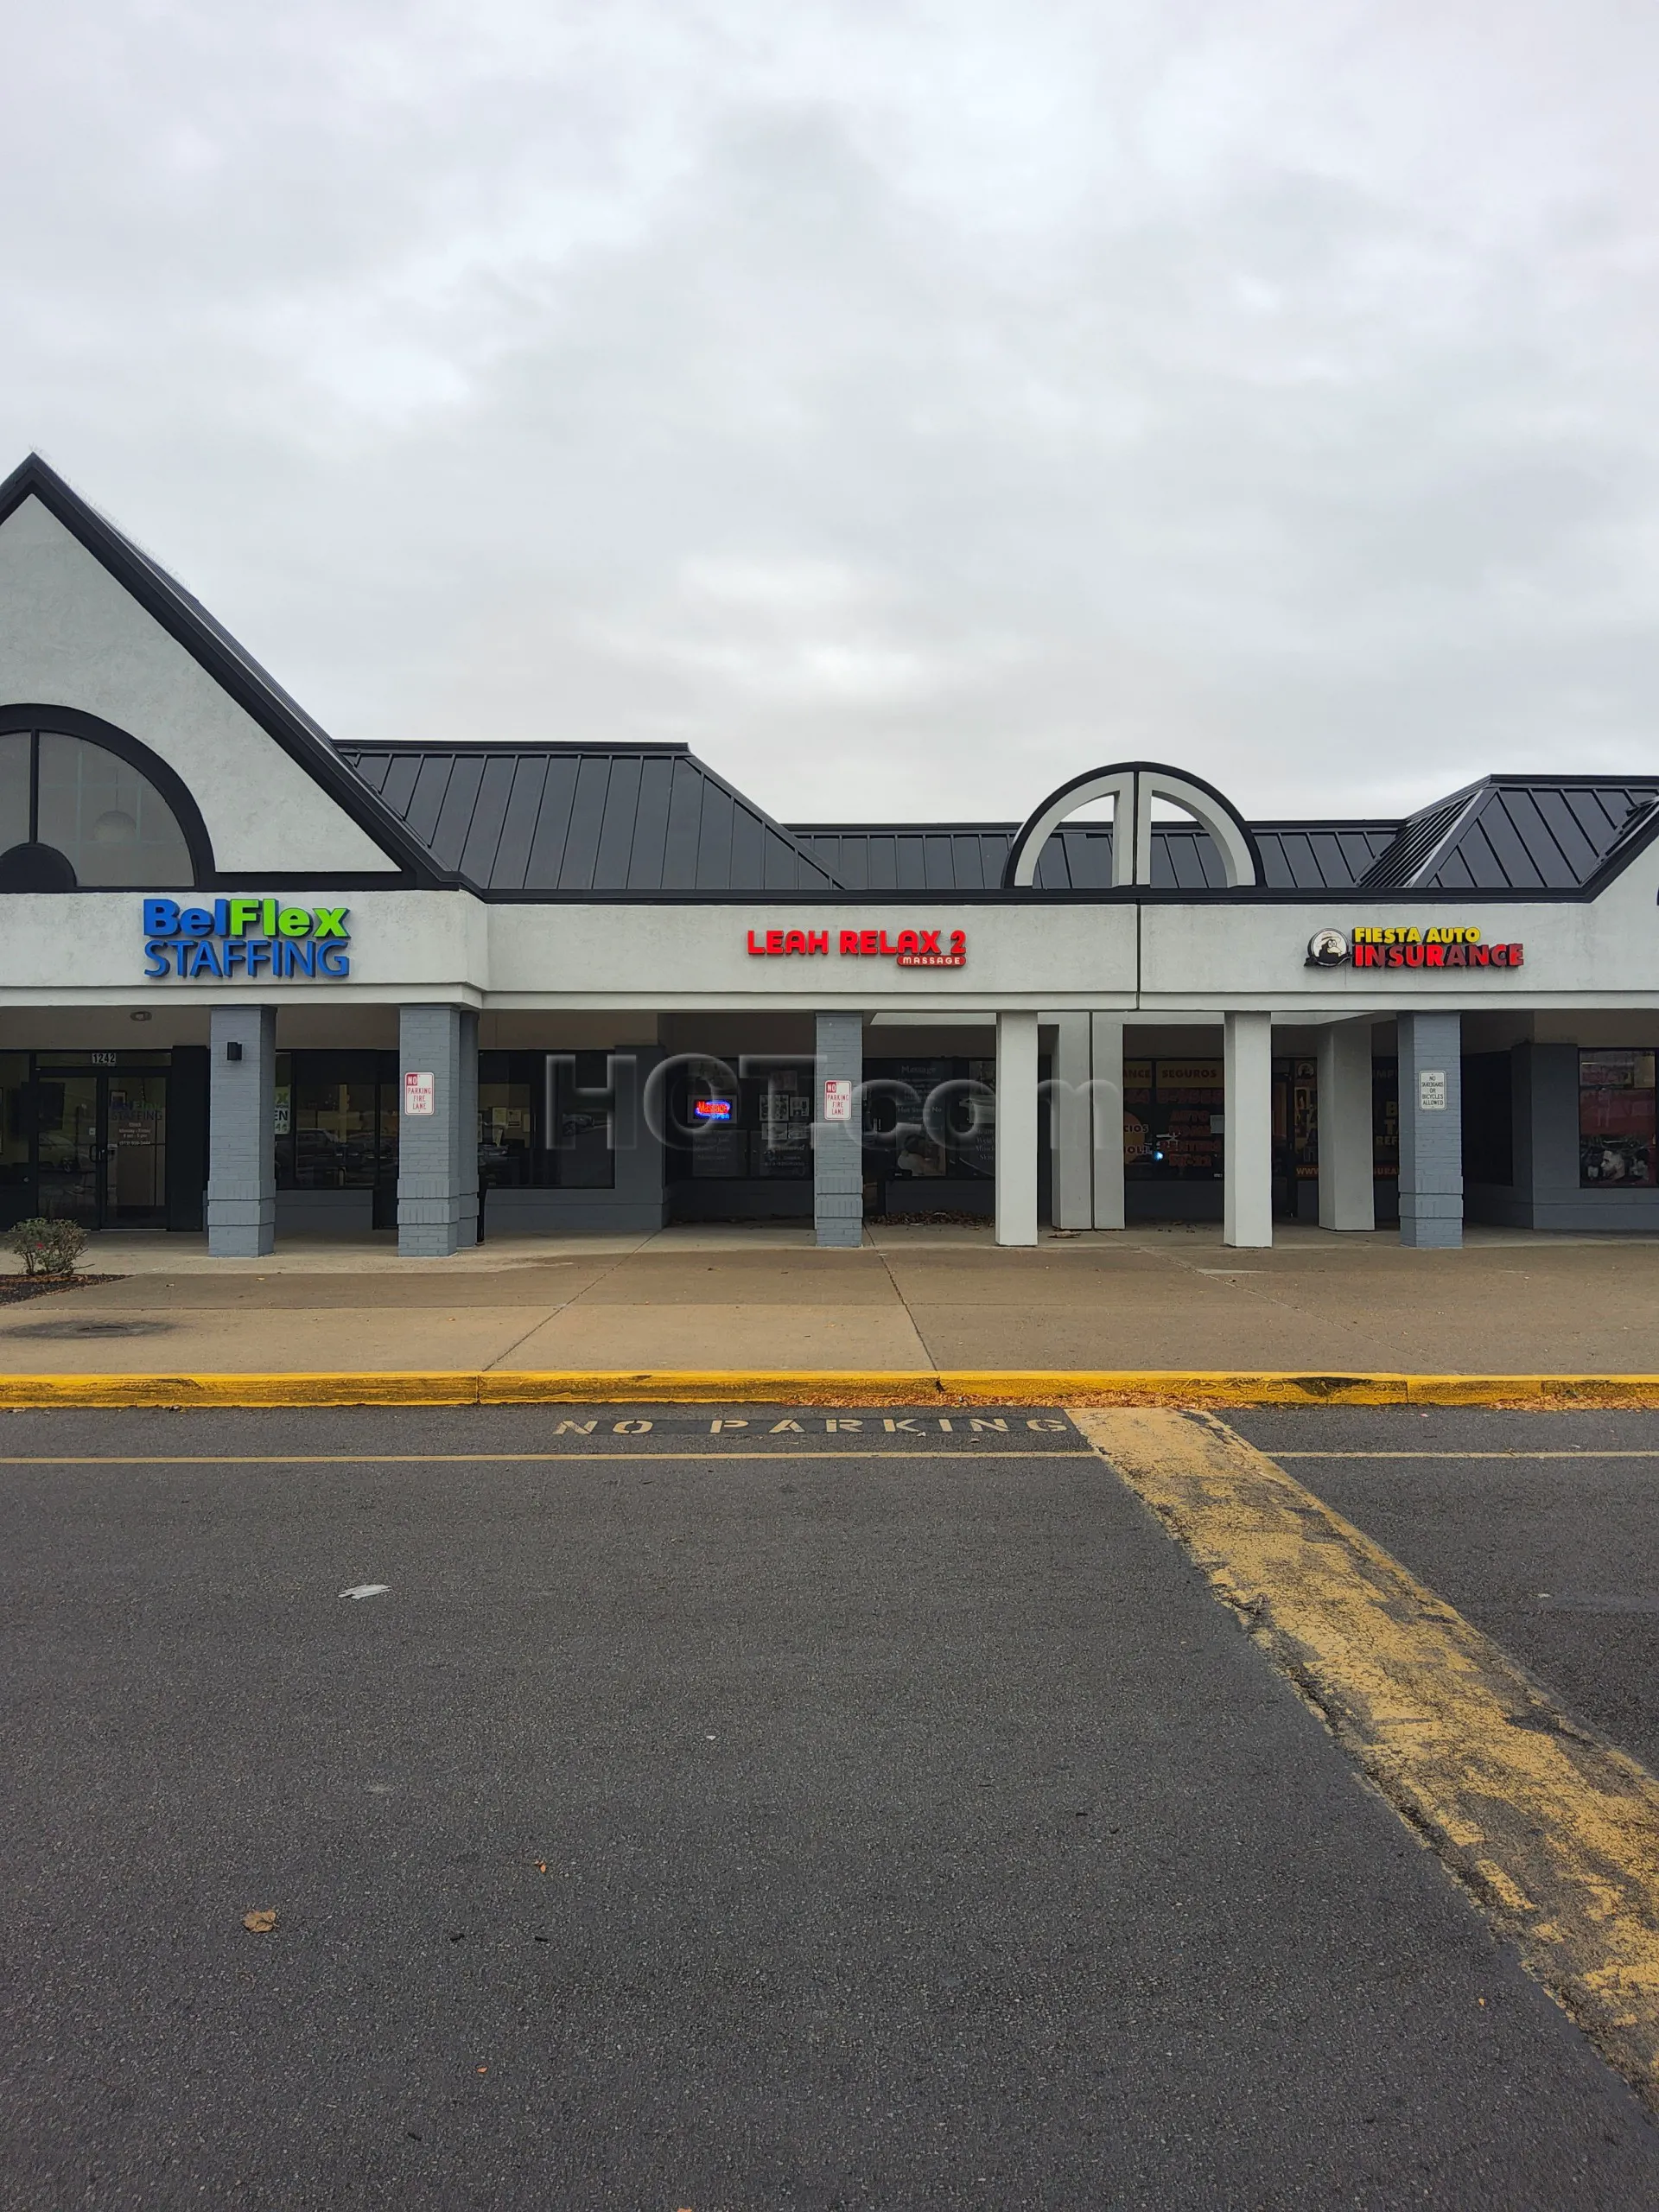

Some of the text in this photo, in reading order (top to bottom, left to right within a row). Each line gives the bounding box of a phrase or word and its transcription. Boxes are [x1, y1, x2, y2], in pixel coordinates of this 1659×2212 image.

[143, 899, 350, 938] BelFlex
[747, 930, 966, 955] LEAH RELAX 2
[1353, 927, 1481, 944] FIESTA AUTO
[144, 939, 349, 977] STAFFING
[1353, 944, 1524, 967] INSURANCE
[92, 1053, 115, 1063] 1242
[408, 1076, 417, 1085] NO
[1162, 1069, 1217, 1078] SEGUROS
[827, 1083, 836, 1091] NO
[552, 1418, 1067, 1435] NO PARKING
